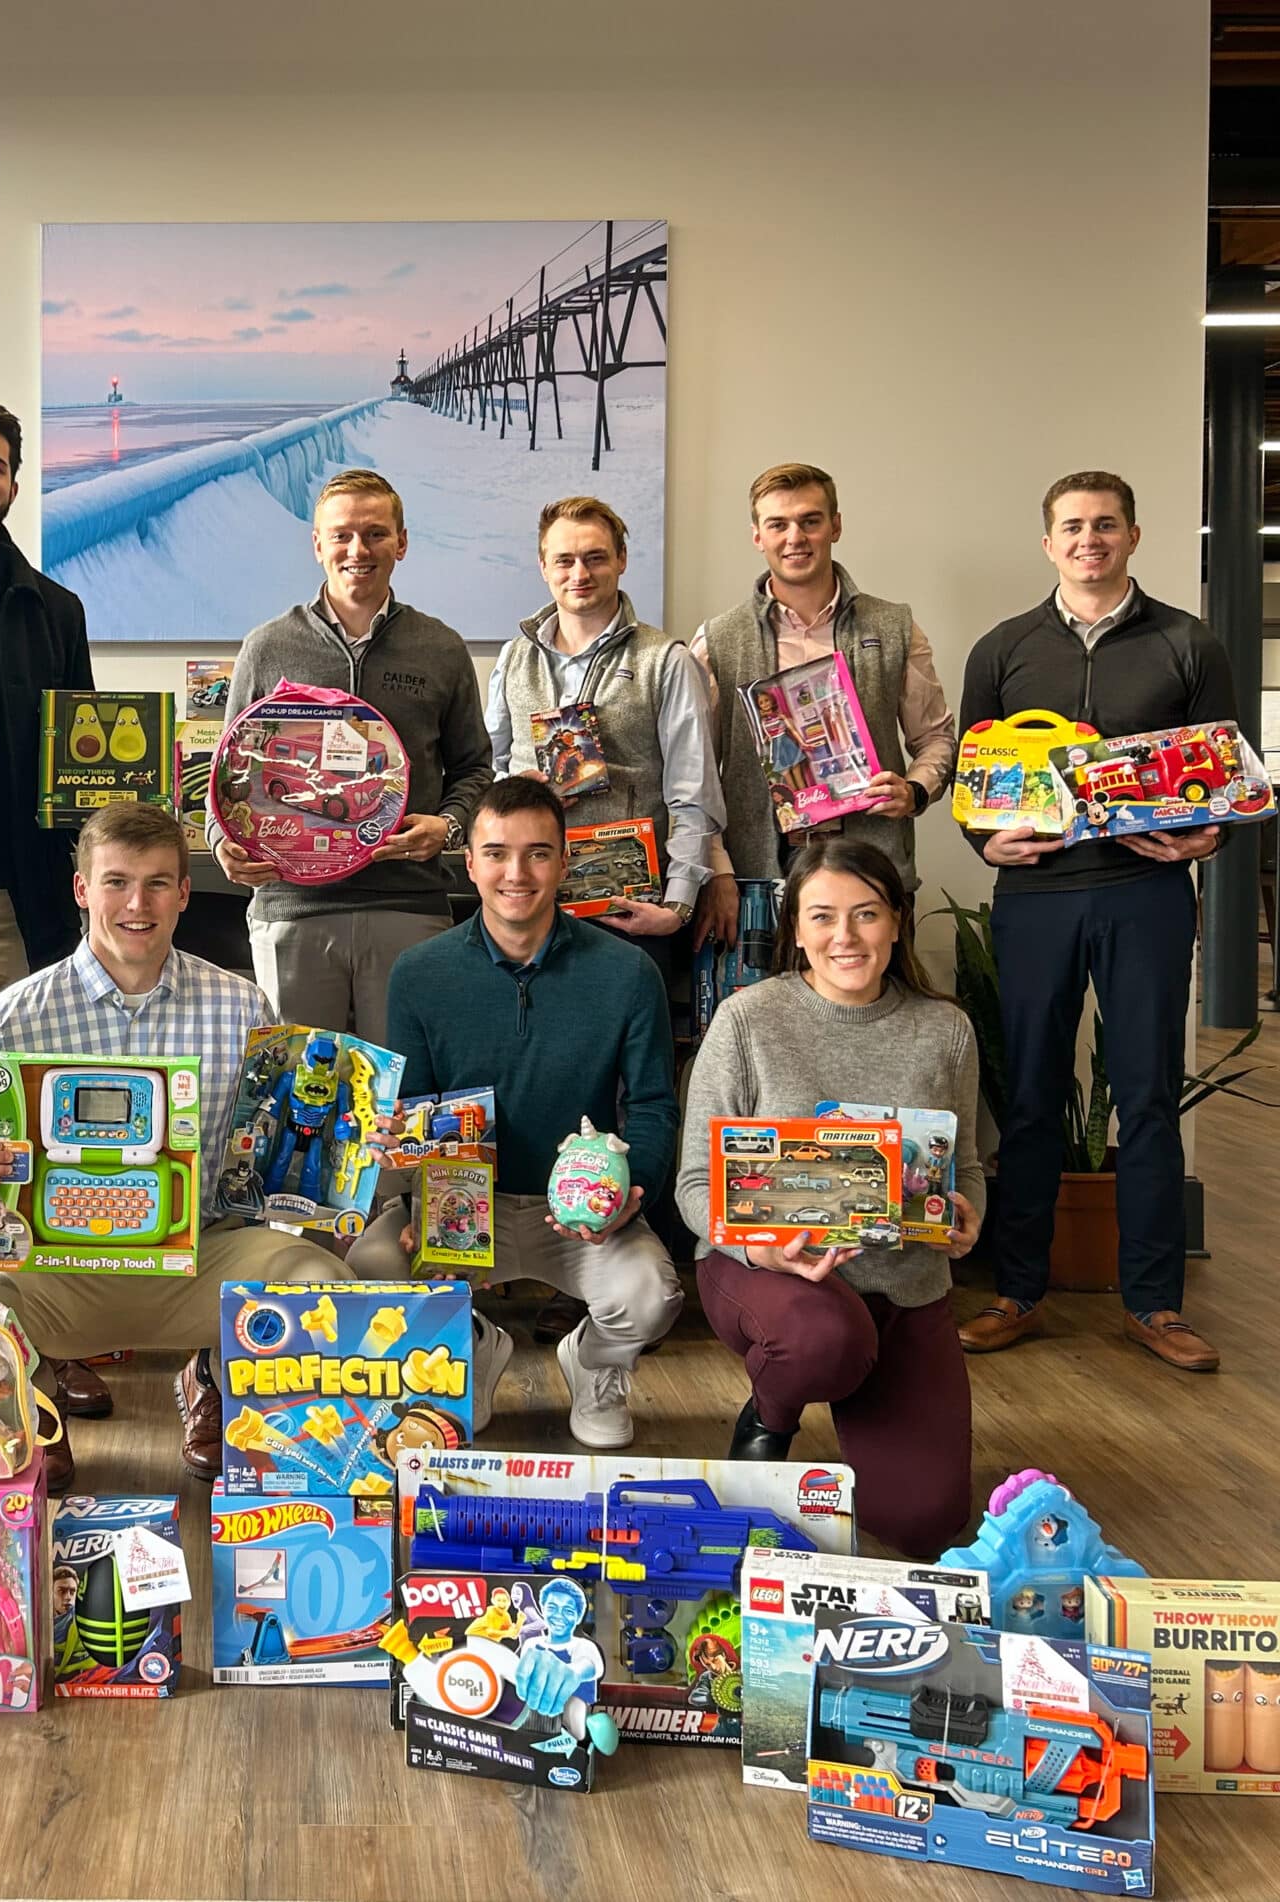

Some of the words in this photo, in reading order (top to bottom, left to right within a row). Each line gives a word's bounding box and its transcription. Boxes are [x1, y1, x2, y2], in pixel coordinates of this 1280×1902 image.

[383, 671, 426, 688] CALDER
[382, 684, 424, 698] CAPITAL
[980, 747, 1018, 756] CLASSIC
[57, 776, 116, 785] AVOCADO
[796, 788, 829, 809] Barbie
[1154, 806, 1195, 818] MICKEY
[258, 816, 301, 837] Barbie
[388, 1058, 402, 1070] DC
[822, 1132, 877, 1141] MATCHBOX
[403, 1143, 434, 1156] Blippi
[431, 1168, 449, 1180] MINI
[452, 1169, 486, 1184] GARDEN
[35, 1255, 70, 1267] 2-in-1
[72, 1256, 121, 1270] LeapTop
[123, 1257, 156, 1269] Touch
[228, 1346, 467, 1397] PERFECTION
[429, 1457, 469, 1470] BLASTS
[471, 1458, 487, 1470] UP
[488, 1459, 503, 1471] TO
[505, 1458, 535, 1477] 100
[537, 1461, 574, 1479] FEET
[4, 1494, 32, 1511] 20+
[799, 1490, 841, 1500] LONG
[401, 1582, 458, 1608] bop
[452, 1581, 484, 1619] it!
[752, 1587, 782, 1604] LEGO
[1153, 1611, 1215, 1625] THROW
[1216, 1613, 1278, 1627] THROW
[750, 1623, 768, 1636] 9+
[813, 1624, 943, 1662] NERF
[1153, 1628, 1278, 1652] BURRITO
[1152, 1668, 1190, 1676] ODGEBALL
[81, 1686, 129, 1697] WEATHER
[130, 1687, 155, 1697] BLITZ
[448, 1675, 474, 1690] bop
[470, 1681, 484, 1696] it!
[427, 1718, 467, 1739] CLASSIC
[468, 1729, 497, 1748] GAME
[1028, 1724, 1092, 1739] COMMANDER
[1153, 1738, 1178, 1746] ROW
[469, 1742, 492, 1757] TWIST
[504, 1753, 521, 1767] PULL
[825, 1818, 862, 1830] WARNING:
[985, 1829, 1101, 1862] ELITE
[1101, 1850, 1132, 1867] 2.0
[1015, 1855, 1084, 1874] COMMANDER
